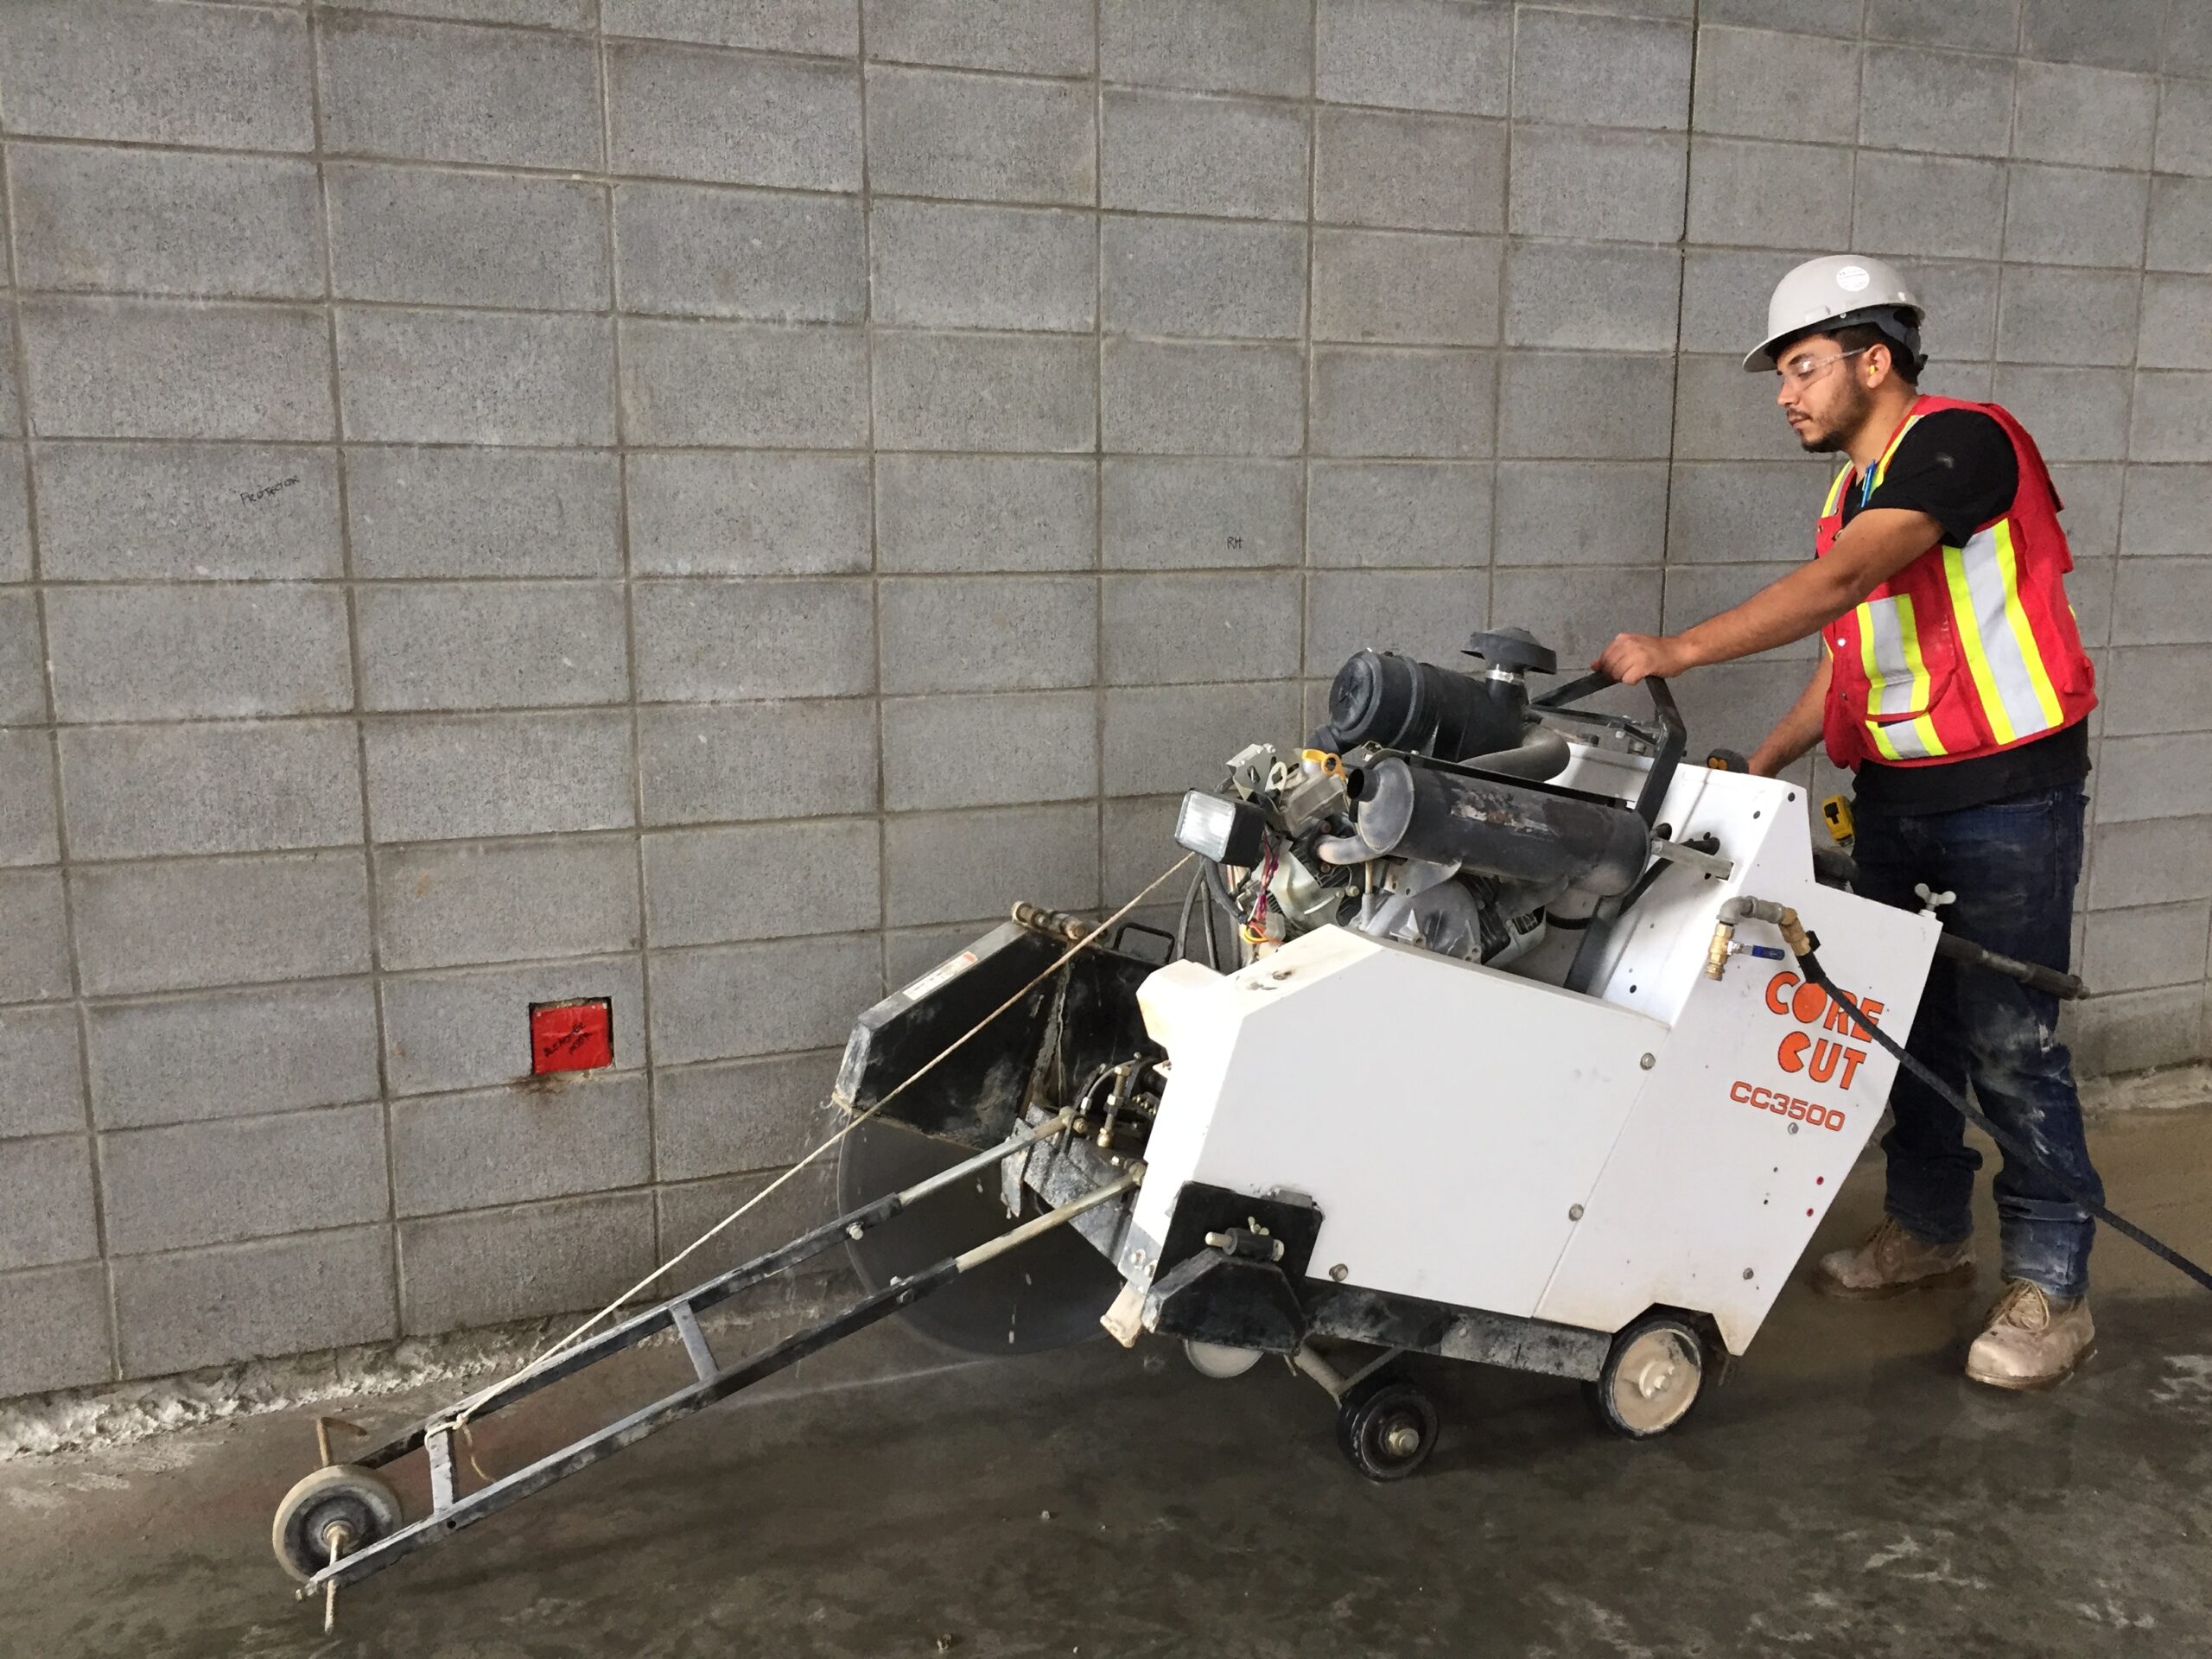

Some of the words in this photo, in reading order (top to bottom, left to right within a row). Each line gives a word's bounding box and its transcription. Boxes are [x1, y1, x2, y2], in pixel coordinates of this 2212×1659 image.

[1765, 971, 1885, 1043] CORE
[1778, 1031, 1867, 1090] CUT
[1730, 1081, 1846, 1132] CC3500
